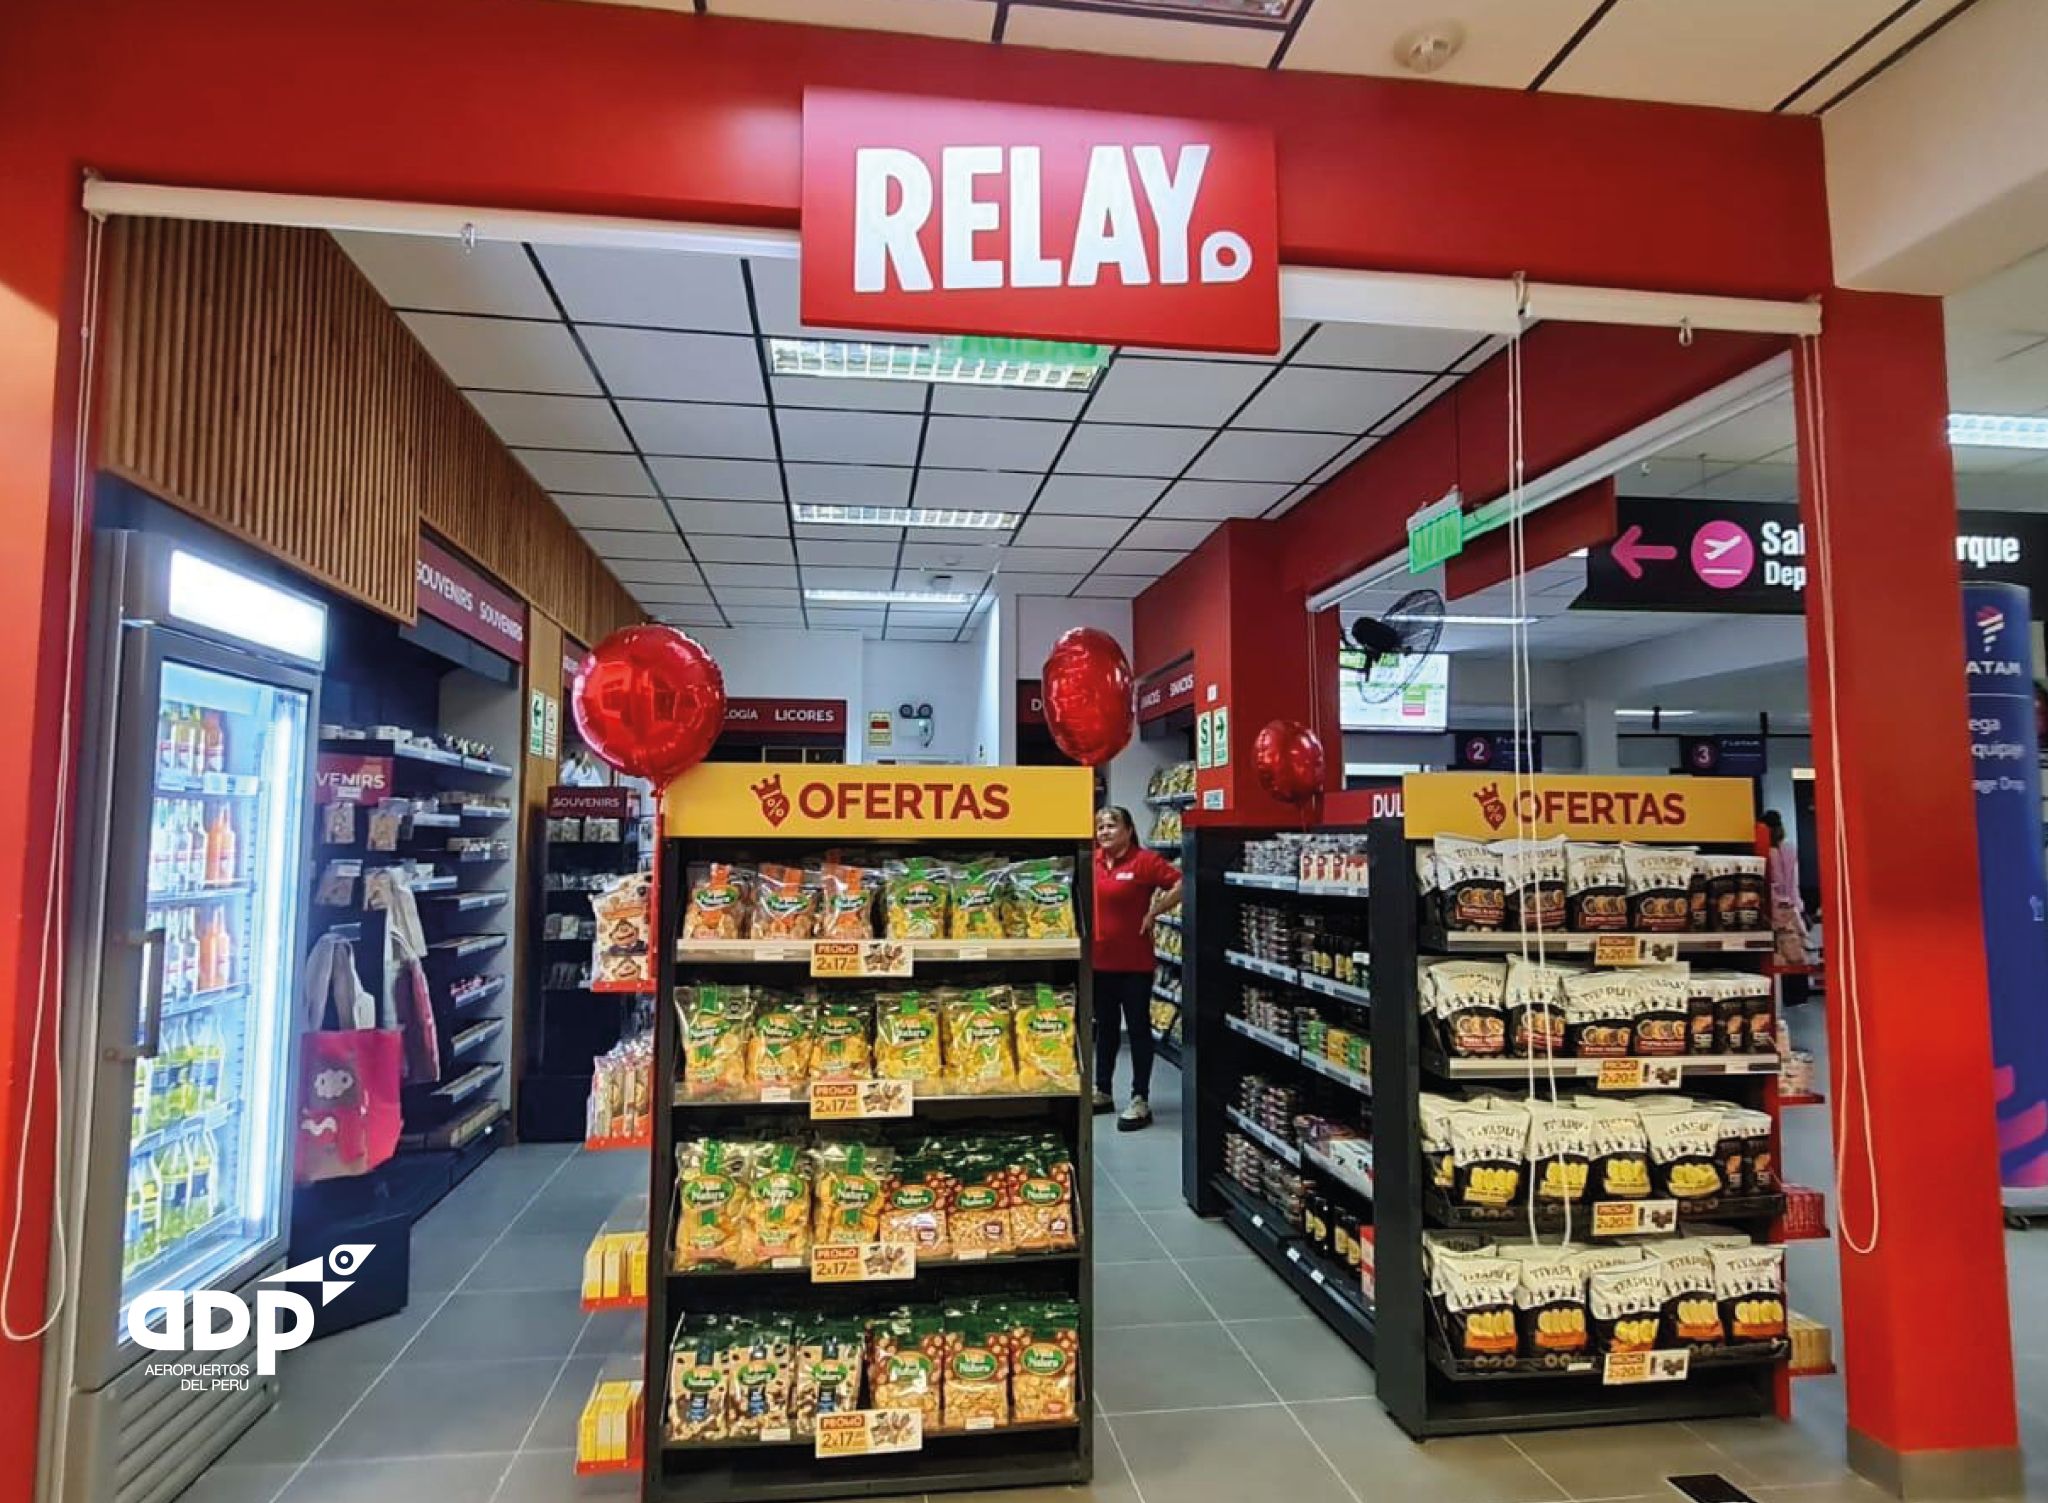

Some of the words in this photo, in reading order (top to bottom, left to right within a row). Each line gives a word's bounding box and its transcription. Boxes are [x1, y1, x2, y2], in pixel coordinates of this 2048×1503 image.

[774, 709, 835, 721] LICORES
[1472, 741, 1486, 761] 2
[1697, 744, 1710, 764] 3
[314, 772, 386, 790] VENIRS
[552, 796, 620, 809] SOUVENIRS
[798, 782, 1011, 820] OFERTAS
[1372, 792, 1405, 818] DUL
[1513, 791, 1686, 826] OFERTAS
